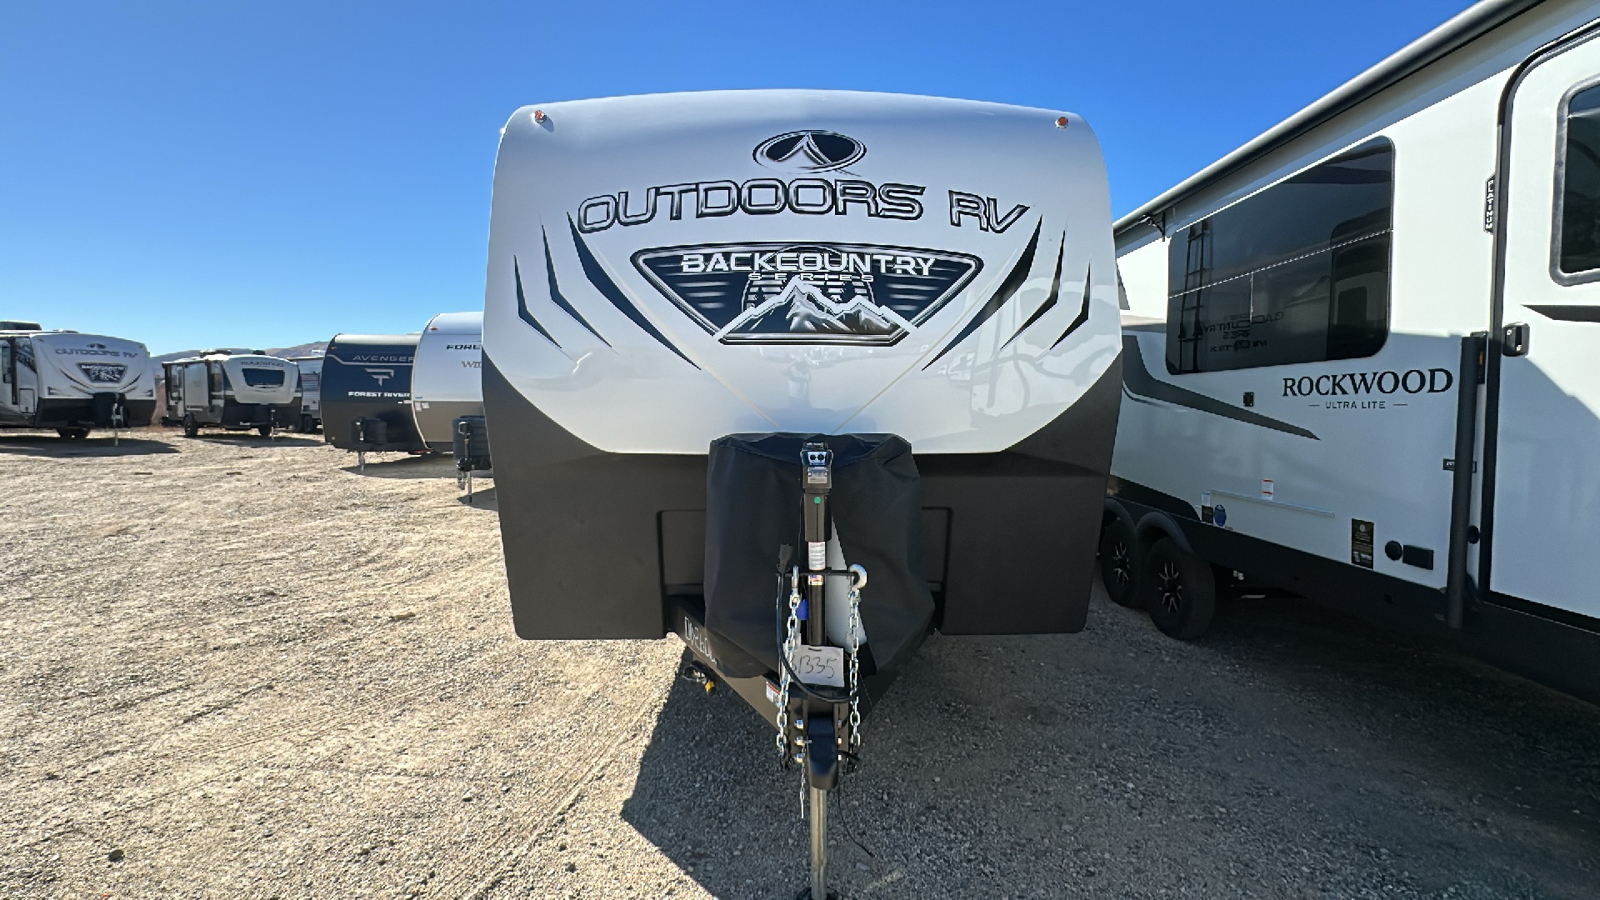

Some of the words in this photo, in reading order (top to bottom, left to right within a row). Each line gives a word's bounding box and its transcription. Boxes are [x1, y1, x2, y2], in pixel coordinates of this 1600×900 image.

[578, 178, 926, 233] OUTDOORS
[948, 189, 1030, 233] RV
[681, 252, 936, 276] BACKCOUNTRY
[749, 271, 875, 282] SERIES
[55, 348, 120, 357] OUTDOORS
[352, 354, 415, 362] AVENGER
[1282, 368, 1453, 397] ROCKWOOD
[1325, 401, 1358, 409] ULTRA
[1361, 401, 1386, 409] LITE
